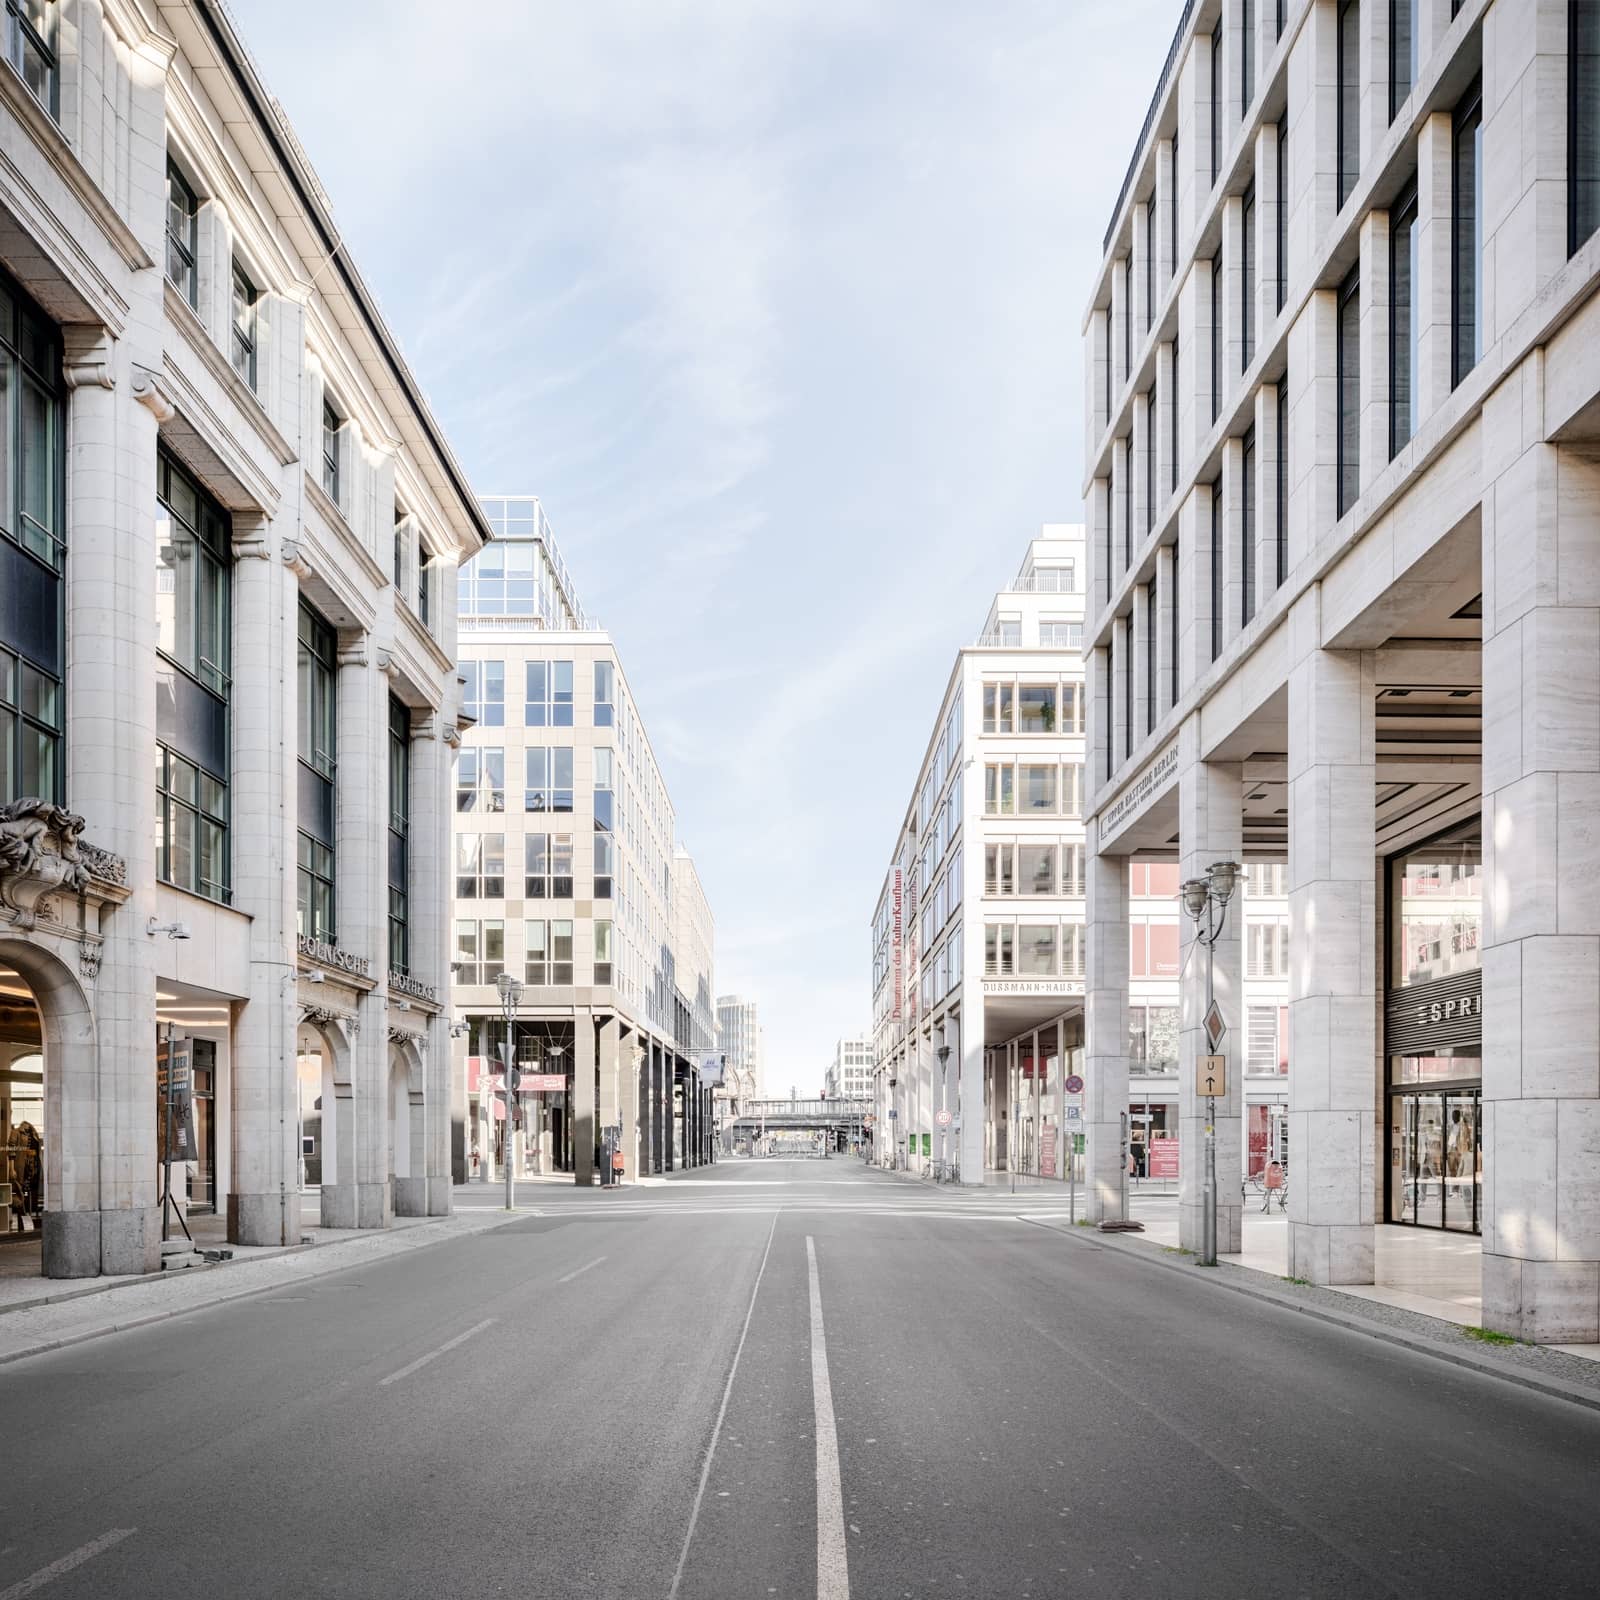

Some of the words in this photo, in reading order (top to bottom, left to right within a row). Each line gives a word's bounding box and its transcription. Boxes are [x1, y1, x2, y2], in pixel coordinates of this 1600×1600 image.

[1108, 803, 1124, 823] UPPER
[1125, 770, 1153, 806] EASTSIDE
[1154, 744, 1179, 778] BERLIN
[892, 869, 902, 947] KulturKaufhaus
[296, 931, 368, 976] POLNISCHE
[893, 949, 902, 966] das
[387, 968, 435, 1000] APOTHEKE
[892, 968, 902, 1019] Dussmann
[1417, 994, 1481, 1024] ESPRI
[1207, 1061, 1215, 1071] U
[1069, 1108, 1077, 1119] P
